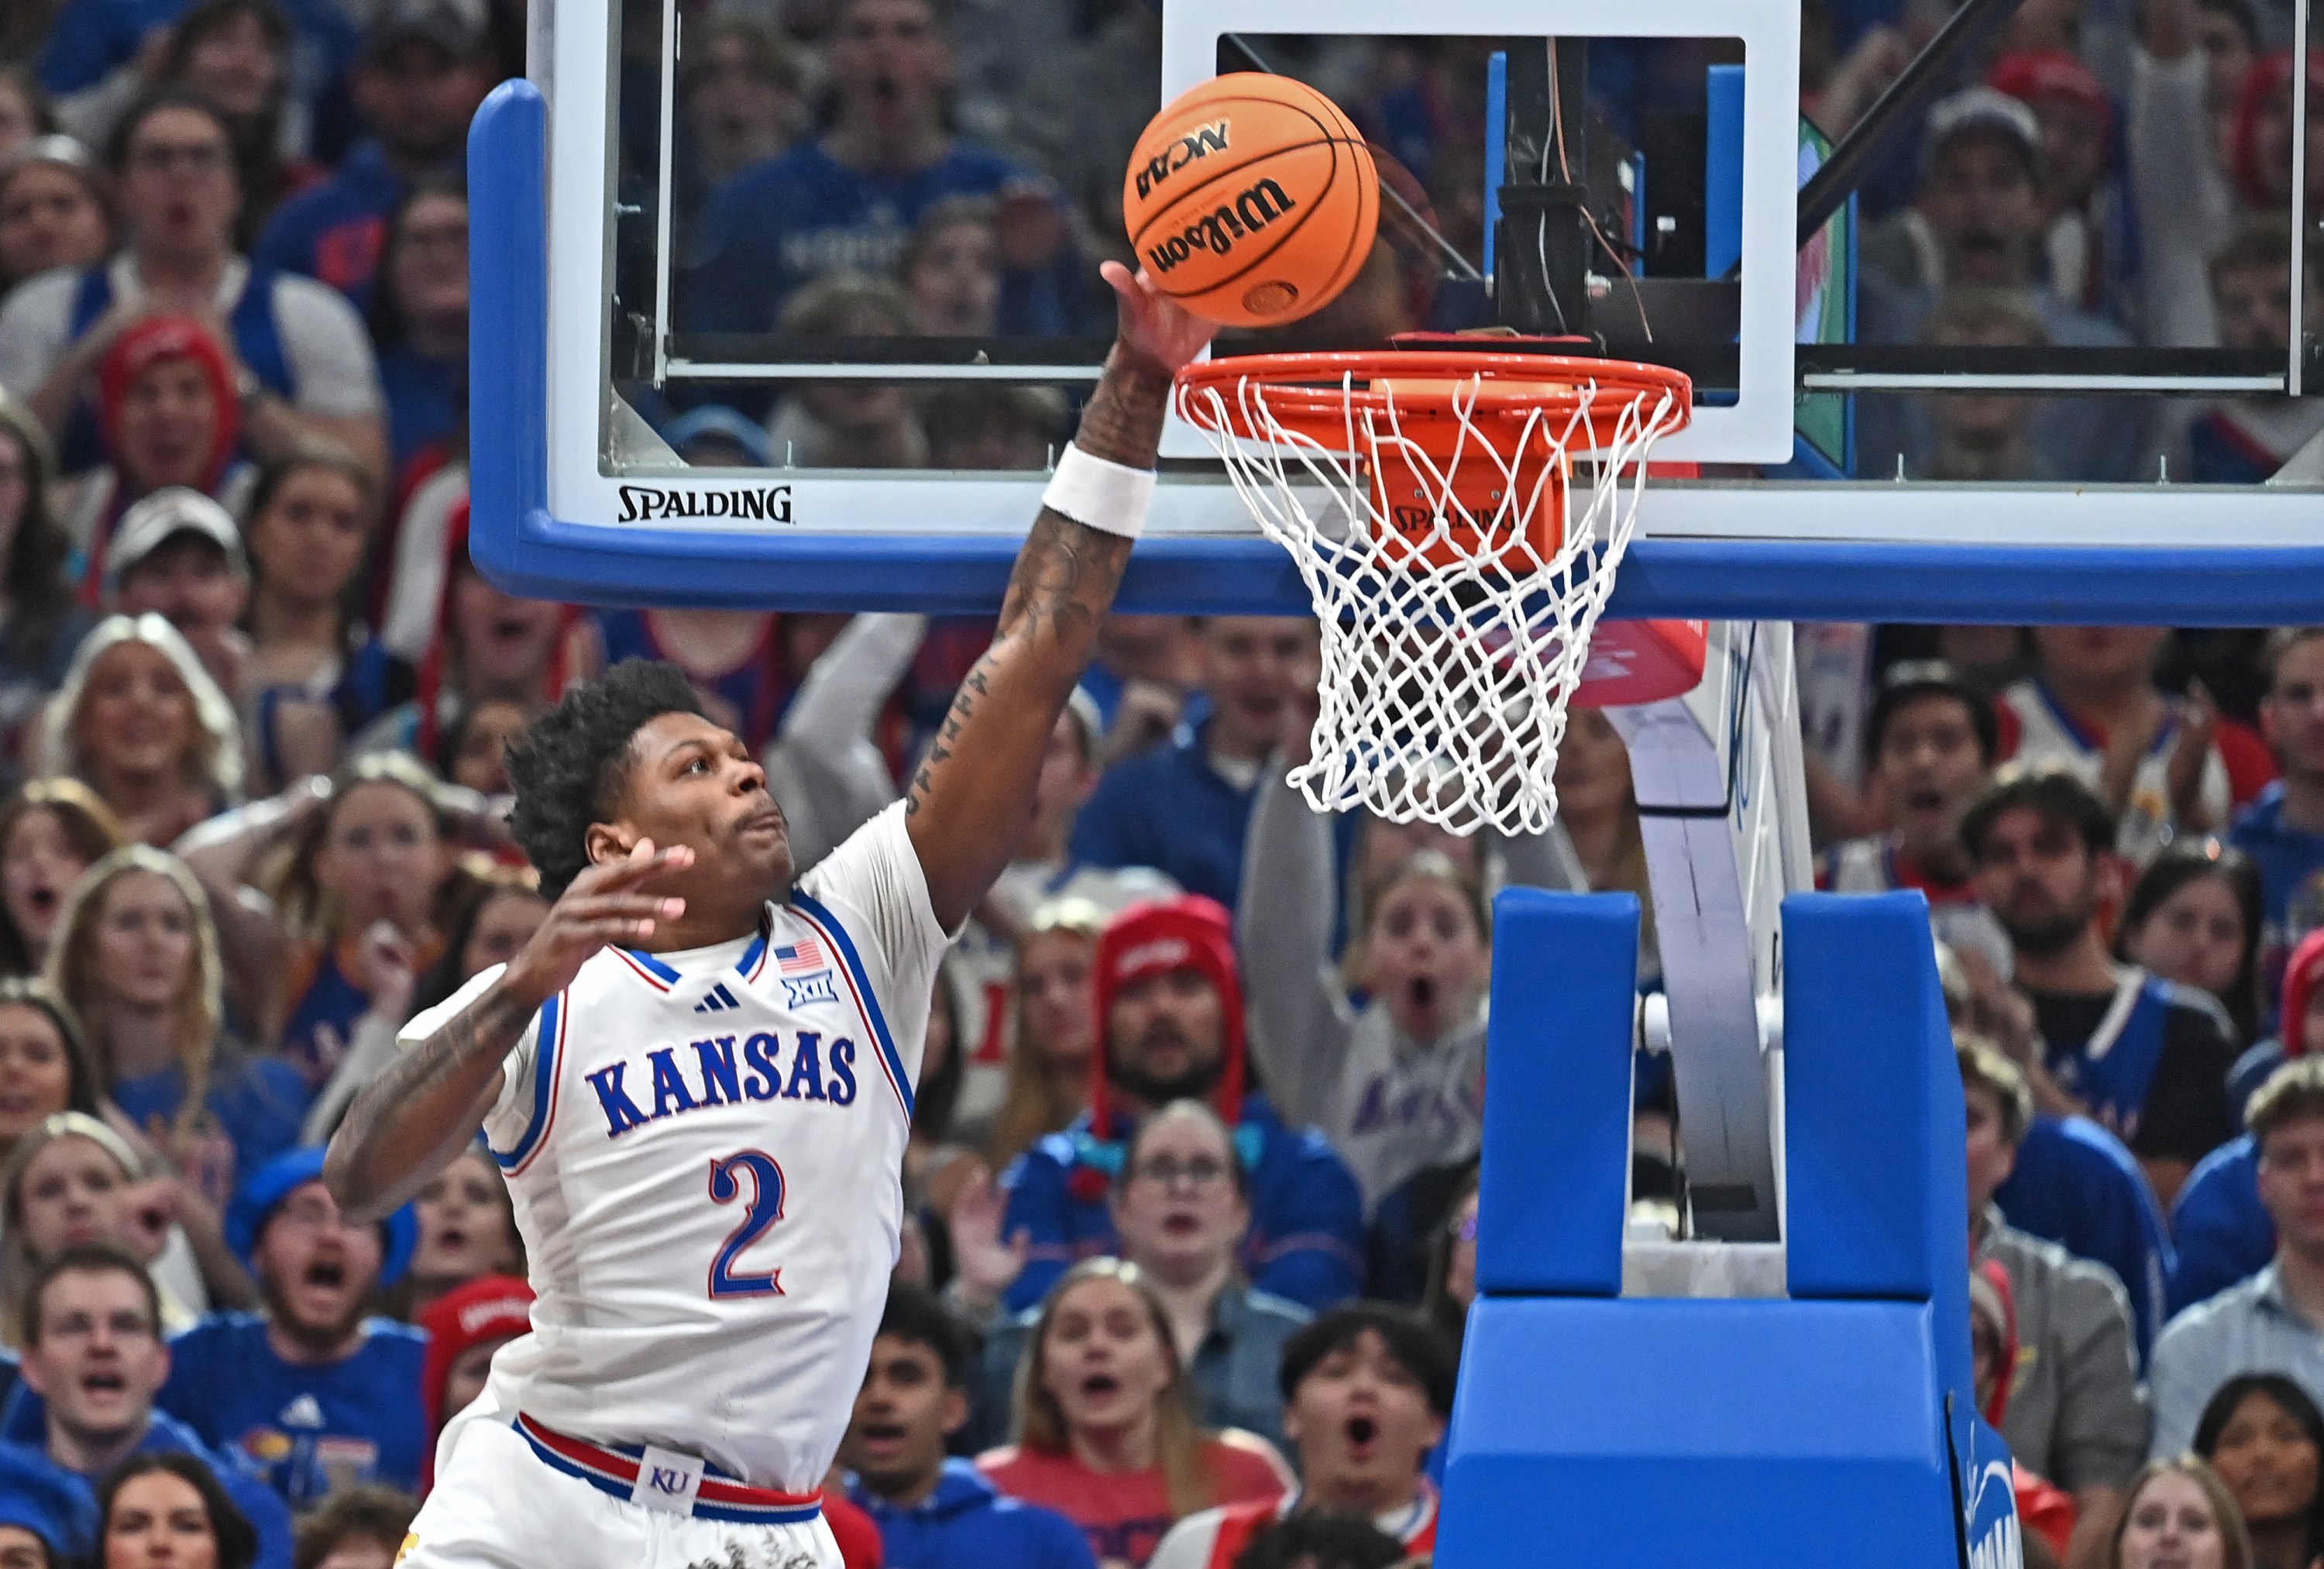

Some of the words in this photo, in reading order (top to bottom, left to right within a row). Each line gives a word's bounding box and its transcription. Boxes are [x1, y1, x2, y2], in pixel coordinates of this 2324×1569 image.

[1148, 177, 1296, 273] Wilson
[618, 485, 791, 524] SPALDING
[585, 1031, 857, 1139] KANSAS
[708, 1148, 786, 1300] 2
[651, 1466, 691, 1495] KU
